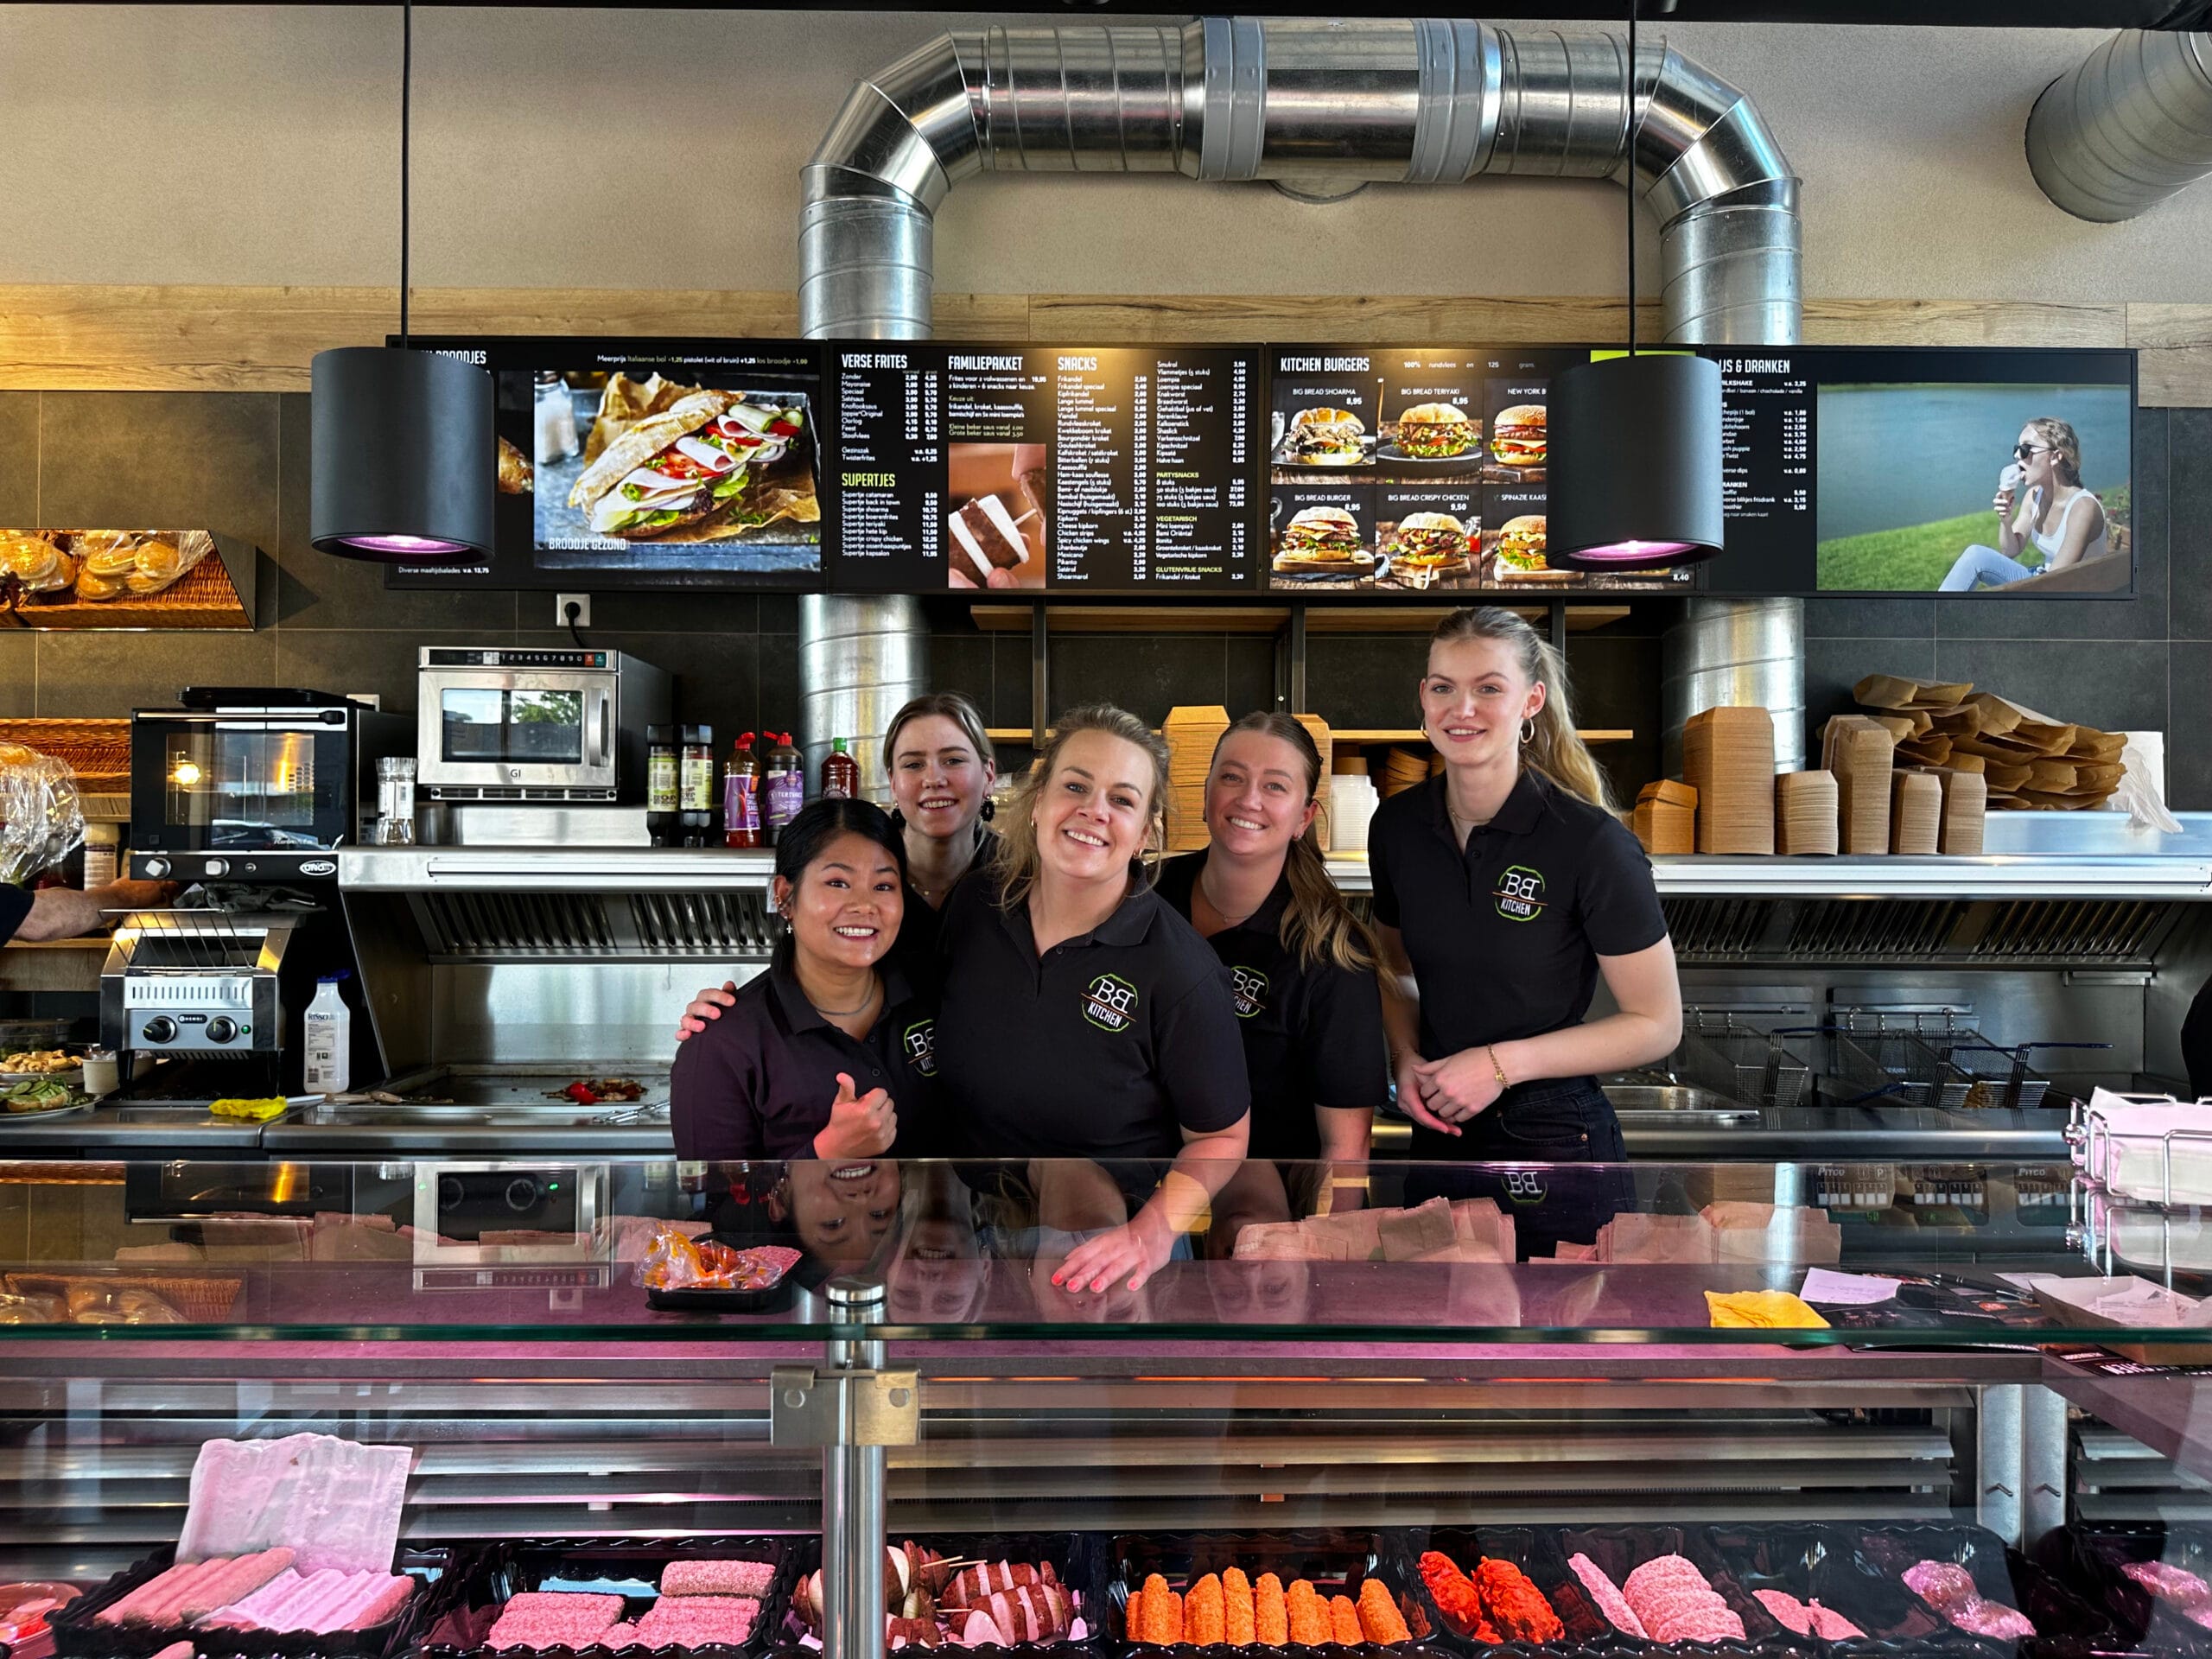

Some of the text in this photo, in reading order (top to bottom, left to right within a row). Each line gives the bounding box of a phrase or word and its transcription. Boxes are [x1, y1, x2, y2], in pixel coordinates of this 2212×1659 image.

[435, 350, 486, 364] OODJES
[597, 355, 626, 365] Meerprijs
[627, 355, 655, 365] Italiaanse
[657, 355, 666, 365] bol
[683, 355, 703, 365] pistolet
[705, 355, 715, 365] (wit
[716, 355, 721, 365] of
[723, 355, 739, 365] bruin)
[757, 355, 766, 365] los
[767, 355, 791, 365] broodje
[842, 354, 907, 369] VERSE FRITES
[949, 356, 1023, 371] FAMILIEPAKKET
[1058, 357, 1097, 371] SNACKS
[1281, 358, 1369, 372] KITCHEN BURGERS
[1404, 360, 1421, 369] 100%
[1428, 360, 1456, 369] rundvlees
[1466, 360, 1474, 369] en
[1488, 360, 1499, 369] 125
[1736, 359, 1742, 373] &
[1745, 359, 1789, 373] DRANKEN
[842, 473, 896, 487] SUPERTJES
[549, 538, 626, 550] BROODJE GEZOND
[1500, 898, 1531, 916] KITCHEN
[1234, 995, 1252, 1014] CHEN
[1087, 1001, 1122, 1028] KITCHEN
